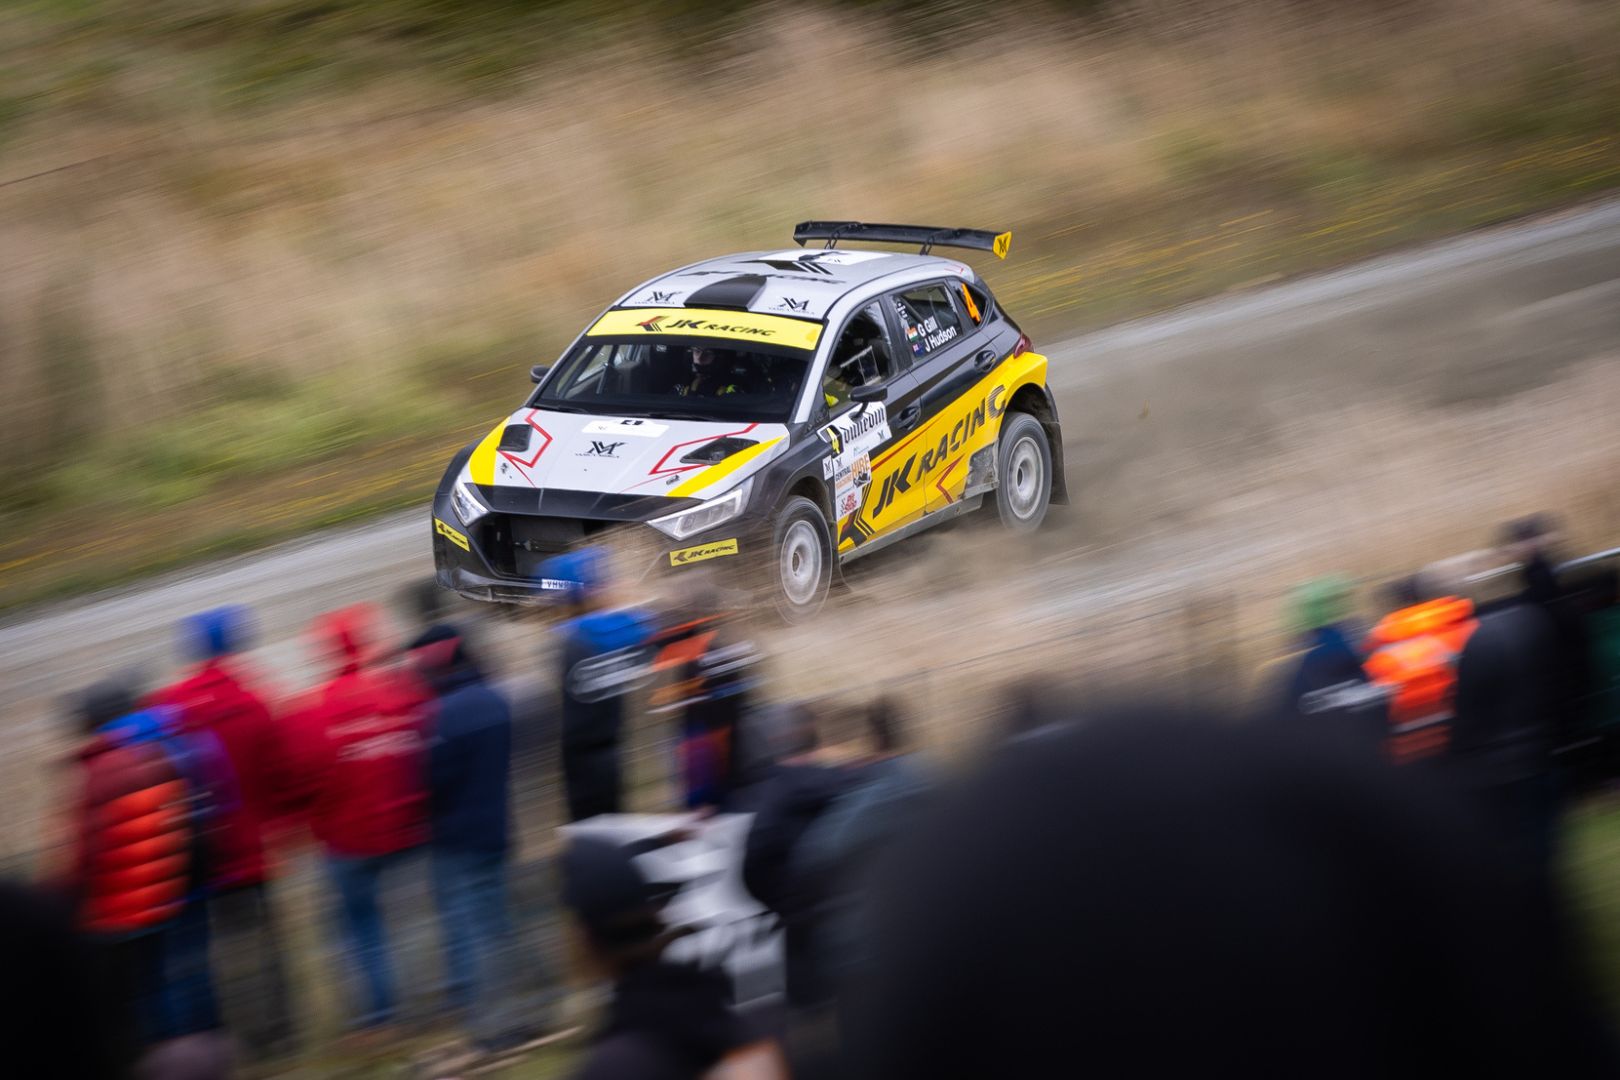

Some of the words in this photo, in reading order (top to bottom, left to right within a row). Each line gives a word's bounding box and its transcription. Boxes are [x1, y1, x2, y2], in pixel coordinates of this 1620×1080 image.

[961, 282, 981, 323] 4
[665, 319, 707, 329] JK
[702, 323, 777, 337] RACING
[917, 323, 926, 337] G
[924, 316, 938, 333] Gill
[925, 340, 931, 352] J
[928, 326, 957, 349] Hudson
[826, 427, 840, 454] 4
[872, 452, 917, 519] JK
[915, 384, 1007, 484] RACING
[851, 454, 870, 477] HIRE
